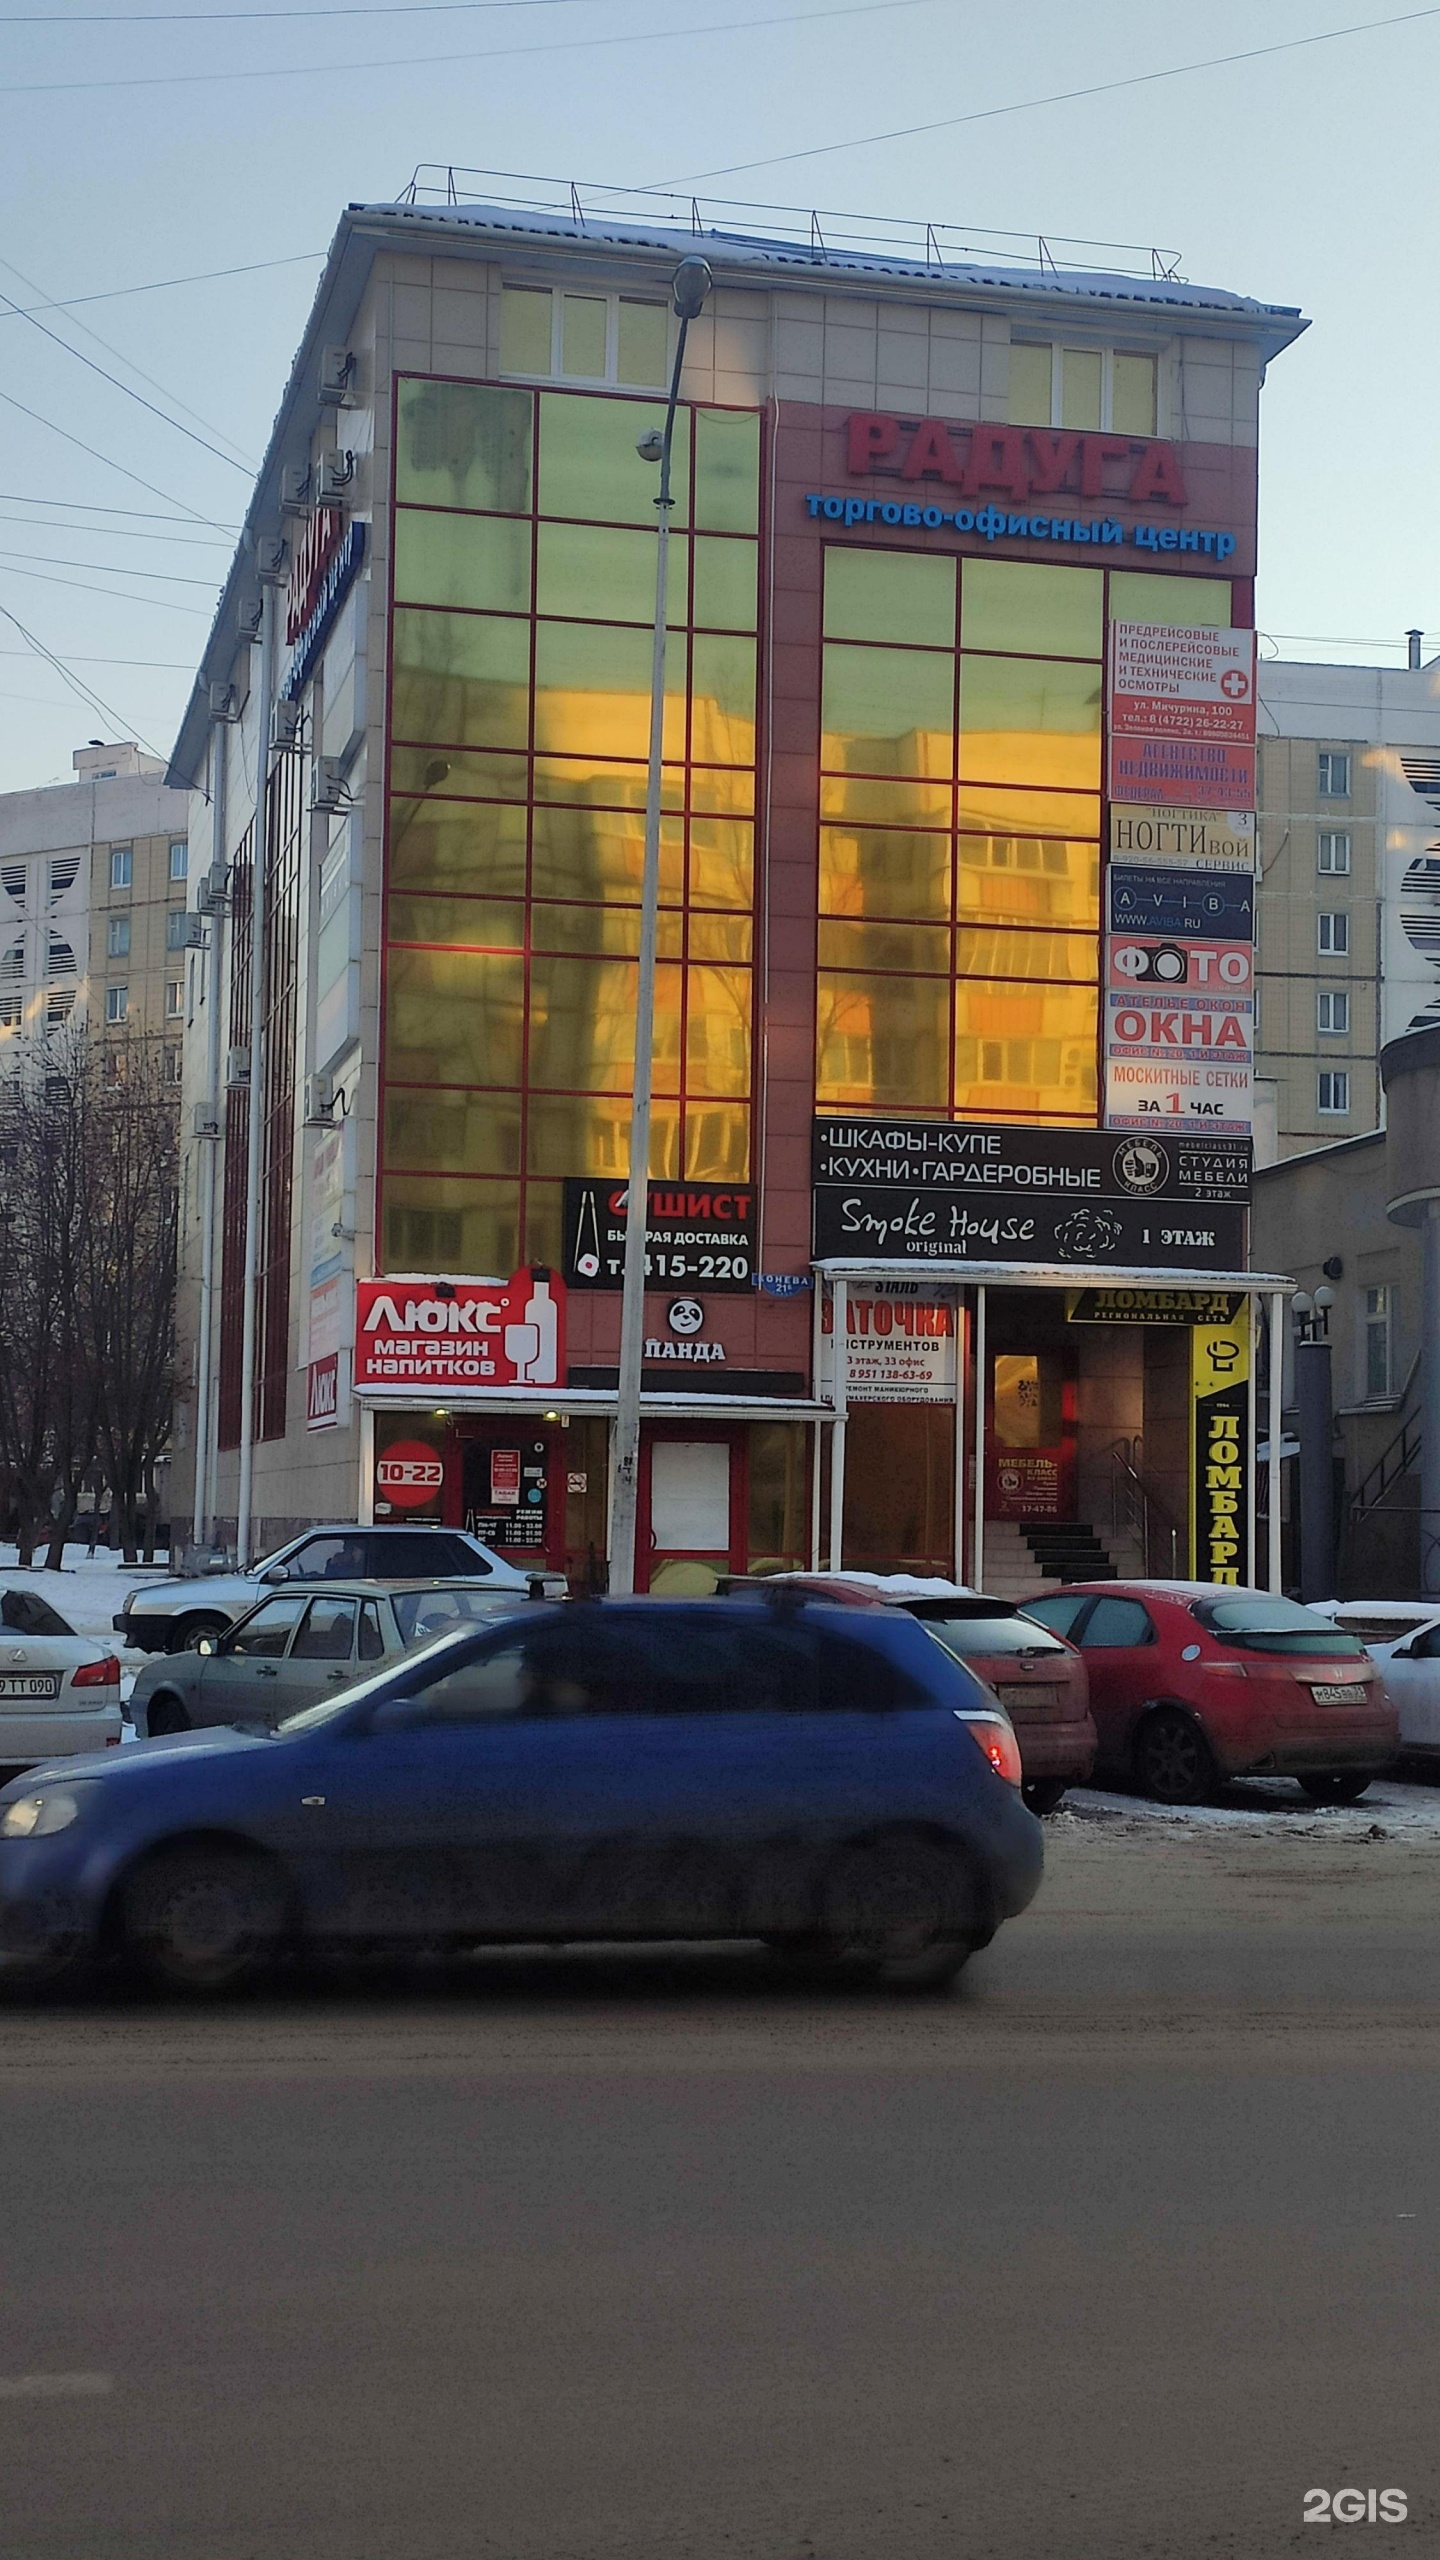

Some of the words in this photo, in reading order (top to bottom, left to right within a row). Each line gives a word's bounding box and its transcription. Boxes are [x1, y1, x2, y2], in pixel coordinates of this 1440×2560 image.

[847, 411, 1188, 506] РАДУГА
[806, 494, 1123, 544] торгово-офисный
[1134, 525, 1237, 560] центр
[286, 507, 331, 645] РАДУГА
[1119, 624, 1219, 642] ПРЕДРЕЙСОВЫЕ
[1119, 638, 1127, 648] И
[1131, 639, 1240, 657] ПОСЛЕРЕЙСОВЫЕ
[1119, 652, 1213, 669] МЕДИЦИНСКИЕ
[1119, 665, 1127, 675] И
[1131, 666, 1217, 683] ТЕХНИЧЕСКИЕ
[1118, 678, 1180, 693] ОСМОТРЫ
[1133, 701, 1148, 710] ул.
[1151, 702, 1210, 716] Мичурина,
[1212, 706, 1232, 716] 100
[1150, 714, 1156, 724] 8
[1158, 715, 1194, 728] (4722)
[1195, 718, 1243, 730] 26-22-27
[1119, 760, 1247, 784] НЕДВИЖИМОСТИ
[1238, 812, 1248, 826] 3
[1195, 859, 1249, 872] СЕРВИС
[1113, 946, 1250, 984] ФОТО
[1116, 996, 1188, 1009] АТЕЛЬЕ
[1196, 999, 1245, 1011] ОКОН
[1114, 1010, 1247, 1048] ОКНА
[1113, 1045, 1148, 1055] ОФИС
[1212, 1050, 1248, 1061] ЭТАЖ
[1114, 1065, 1201, 1086] МОСКИТНЫЕ
[1206, 1070, 1248, 1089] СЕТКИ
[1138, 1099, 1161, 1113] ЗА
[1165, 1092, 1185, 1114] 1
[1190, 1102, 1224, 1115] ЧАС
[1112, 1116, 1147, 1126] ОФИС
[1212, 1121, 1247, 1132] ЭТАЖ
[828, 1127, 1002, 1155] ШКАФЫ-КУПЕ
[1118, 1138, 1163, 1159] МЕБЕЛЬ
[1178, 1155, 1248, 1169] СТУДИЯ
[828, 1157, 910, 1180] КУХНИ
[922, 1161, 1101, 1188] ГАРДЕРОБНЫЕ
[1178, 1170, 1248, 1183] МЕБЕЛИ
[1123, 1180, 1158, 1193] КЛАСС
[1195, 1187, 1202, 1197] 2
[1206, 1189, 1232, 1199] этаж
[608, 1189, 751, 1220] СШИСТ
[840, 1197, 937, 1245] Smoke
[949, 1205, 1035, 1245] House
[607, 1229, 672, 1244] БЫРАЯ
[674, 1231, 749, 1246] ДОСТАВКА
[1142, 1229, 1151, 1244] 1
[1160, 1229, 1216, 1246] ЭТАЖ
[906, 1239, 967, 1256] original
[1094, 1290, 1230, 1315] ЛОМБАРД
[1094, 1311, 1185, 1321] РЕГИОНАЛЬНАЯ
[1197, 1314, 1226, 1322] СЕТЬ
[374, 1339, 489, 1356] магазин
[644, 1338, 726, 1363] ПАНДА
[830, 1339, 940, 1352] СТРУМЕНТОВ
[366, 1358, 496, 1376] напитков
[847, 1356, 853, 1365] 3
[855, 1357, 882, 1366] этаж,
[885, 1356, 897, 1365] 33
[899, 1357, 925, 1368] офис
[849, 1369, 856, 1378] 8
[858, 1369, 877, 1379] 951
[881, 1370, 933, 1380] 138-63-69
[874, 1386, 929, 1394] МАНИКЮРНОГО
[380, 1464, 440, 1482] 10-22
[30, 1679, 53, 1693] 090
